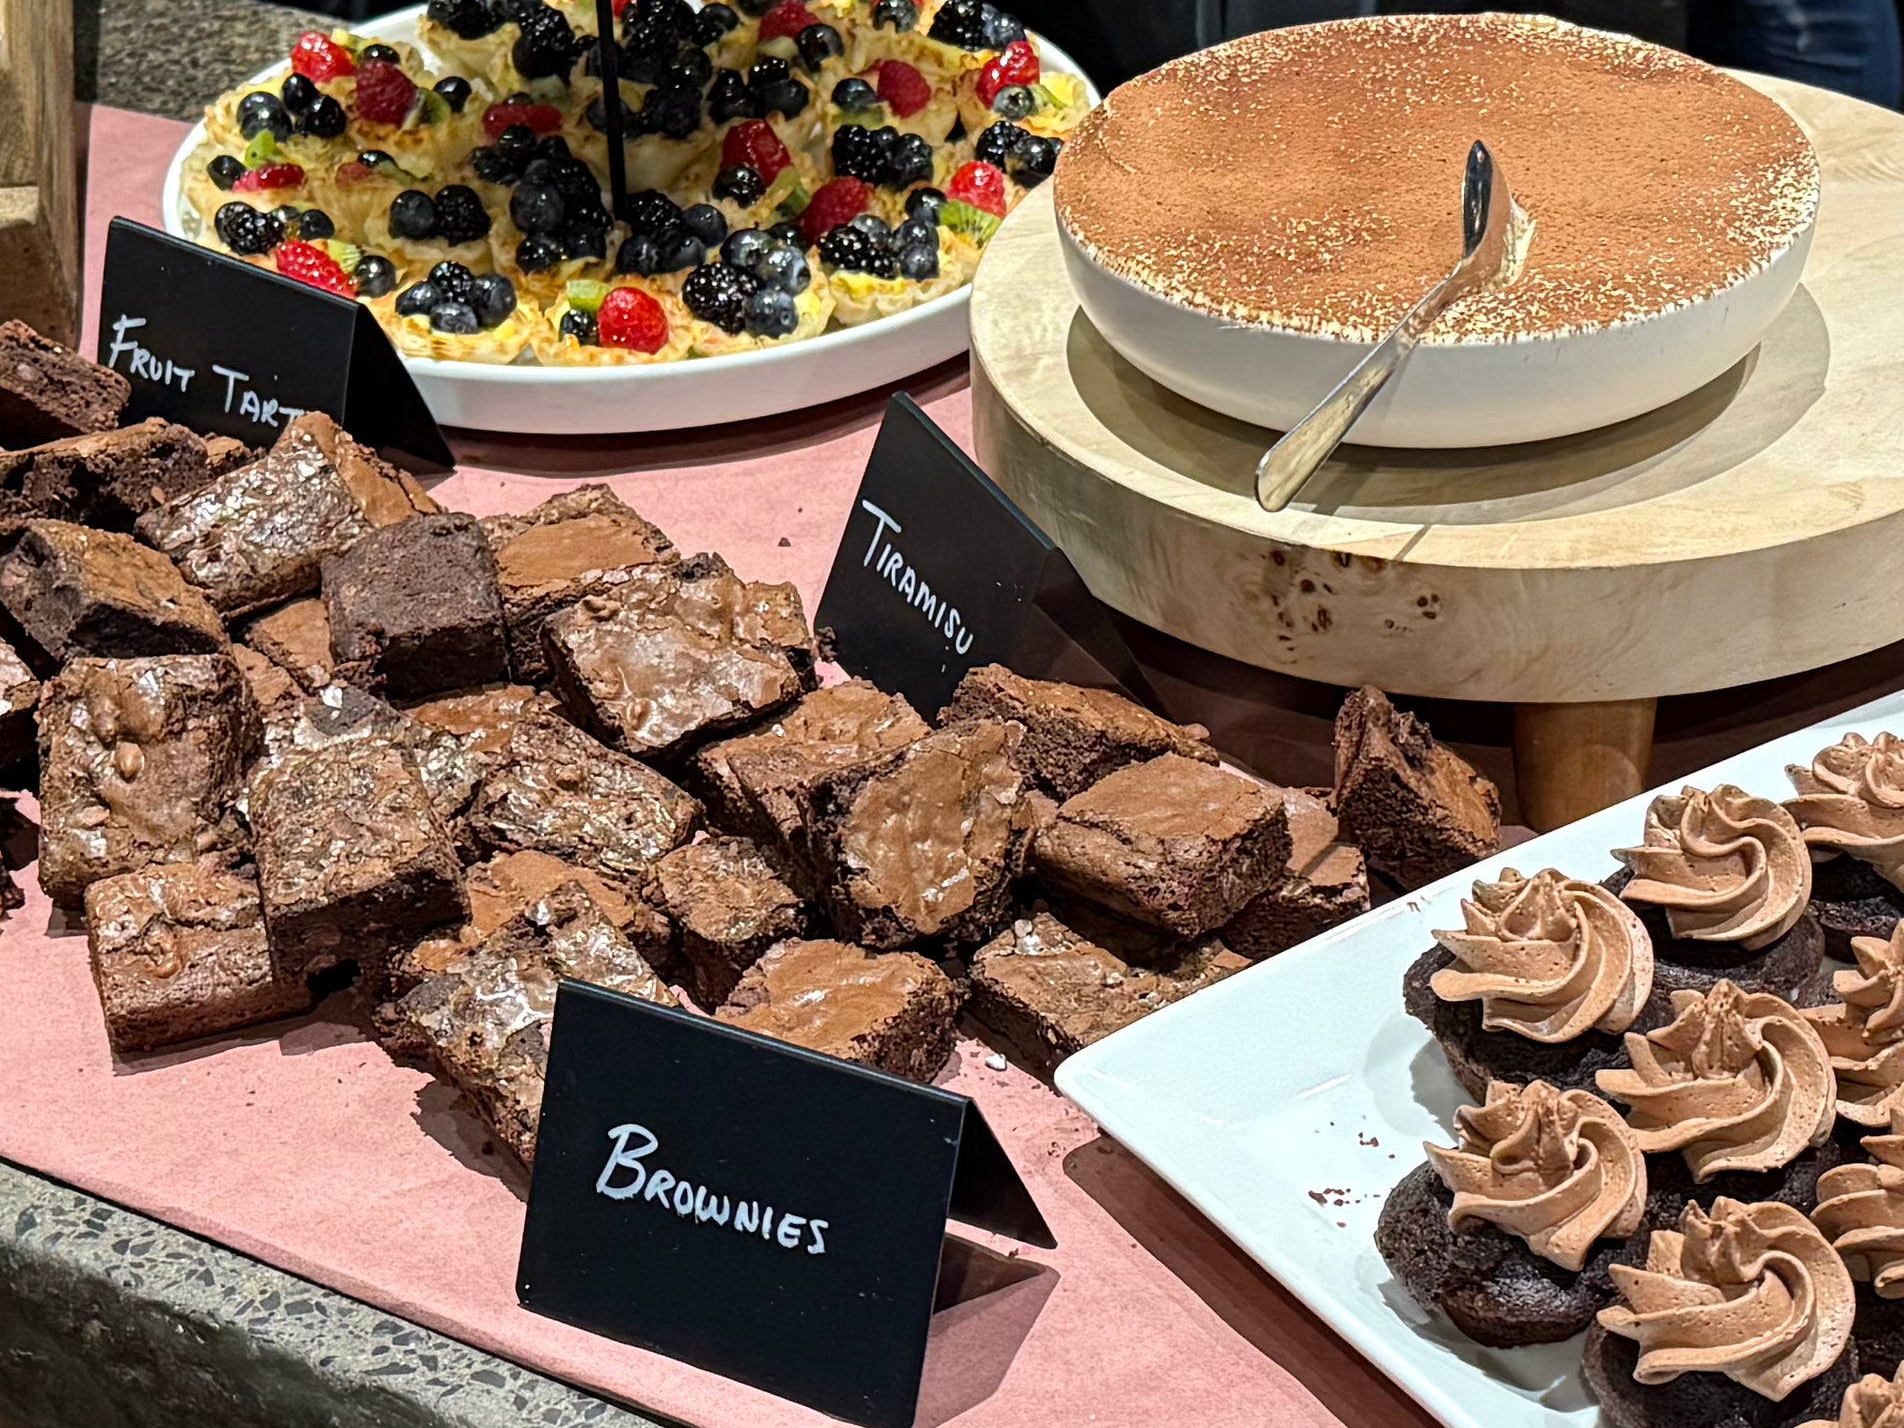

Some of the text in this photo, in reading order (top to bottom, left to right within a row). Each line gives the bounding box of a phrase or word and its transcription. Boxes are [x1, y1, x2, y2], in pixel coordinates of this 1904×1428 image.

[108, 313, 305, 428] FRUIT TART
[861, 499, 974, 655] TIRAMISU
[595, 1123, 830, 1255] BROWNIES
